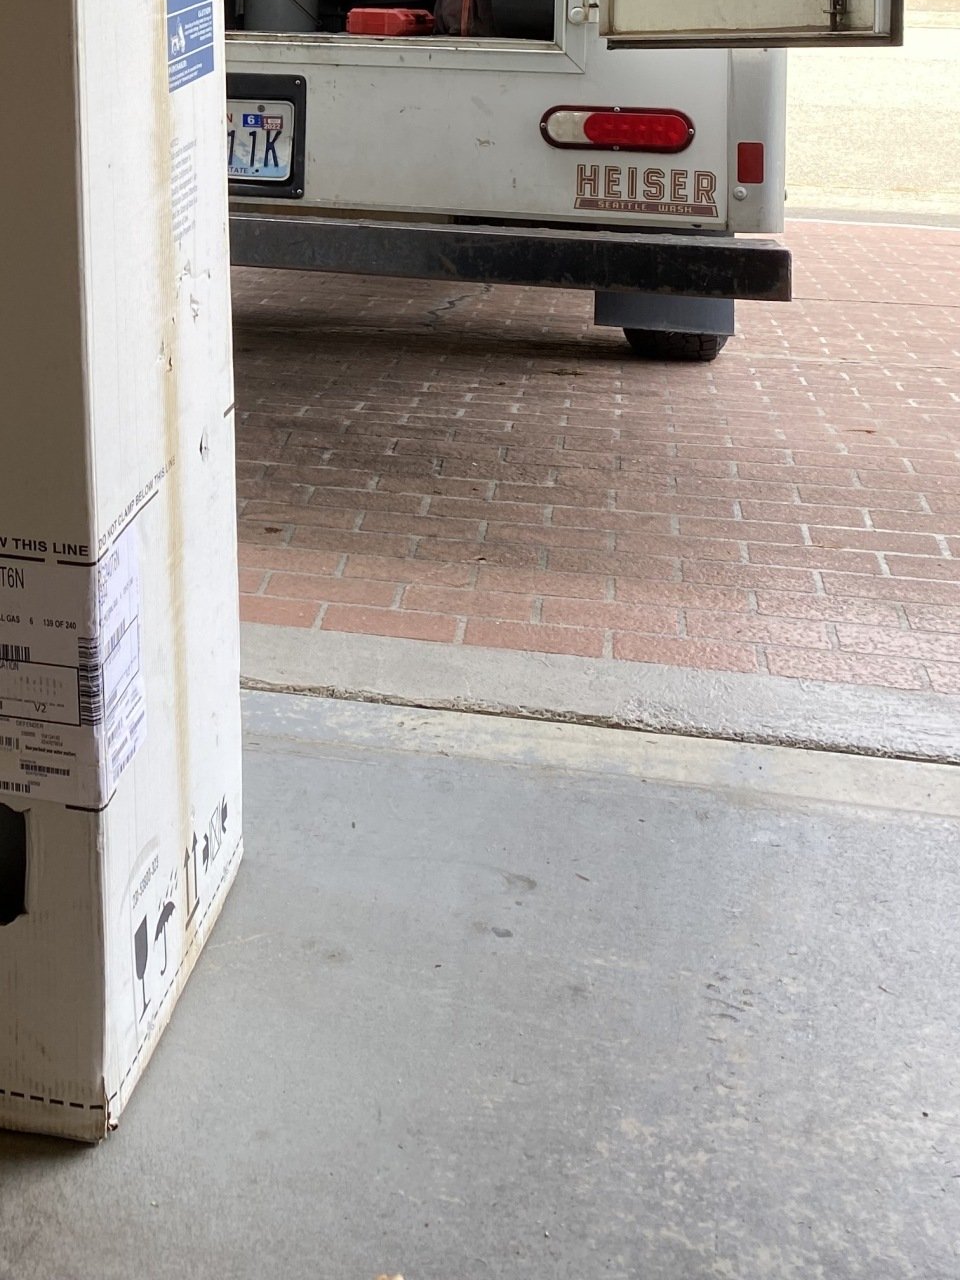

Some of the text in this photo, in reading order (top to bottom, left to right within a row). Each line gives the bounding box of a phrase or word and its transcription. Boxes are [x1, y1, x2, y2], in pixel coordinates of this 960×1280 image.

[247, 115, 255, 124] 6
[576, 164, 717, 204] HEISER
[597, 201, 693, 214] SEATTLE WASH
[12, 537, 47, 553] THIS
[52, 542, 89, 557] LINE
[6, 614, 21, 624] GAS
